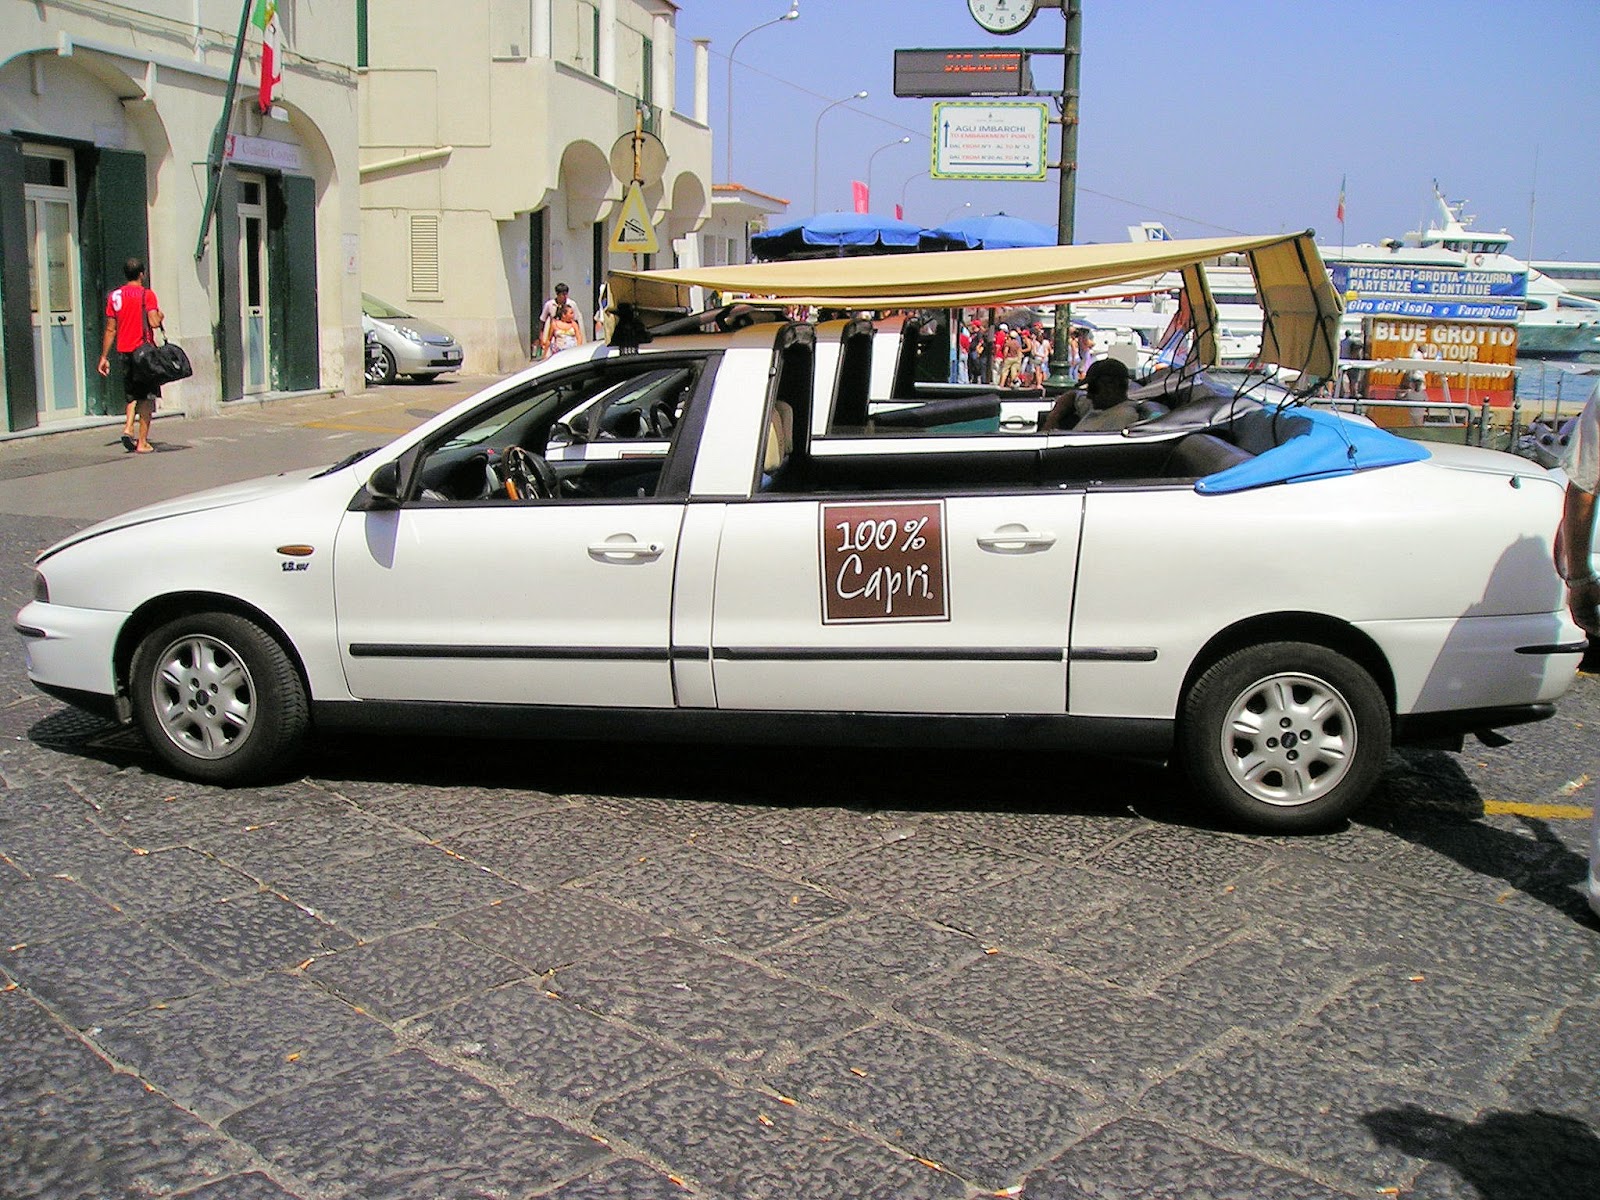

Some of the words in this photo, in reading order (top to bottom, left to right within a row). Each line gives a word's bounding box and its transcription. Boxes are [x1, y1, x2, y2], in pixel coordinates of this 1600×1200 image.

[1350, 279, 1412, 293] PARTENZE
[1431, 283, 1492, 295] CONTINUE
[1349, 300, 1373, 312] Giro
[1457, 304, 1518, 318] Faraglioni
[1375, 321, 1428, 342] BLUE
[1432, 324, 1516, 347] GROTTO
[1442, 344, 1479, 361] TOUR
